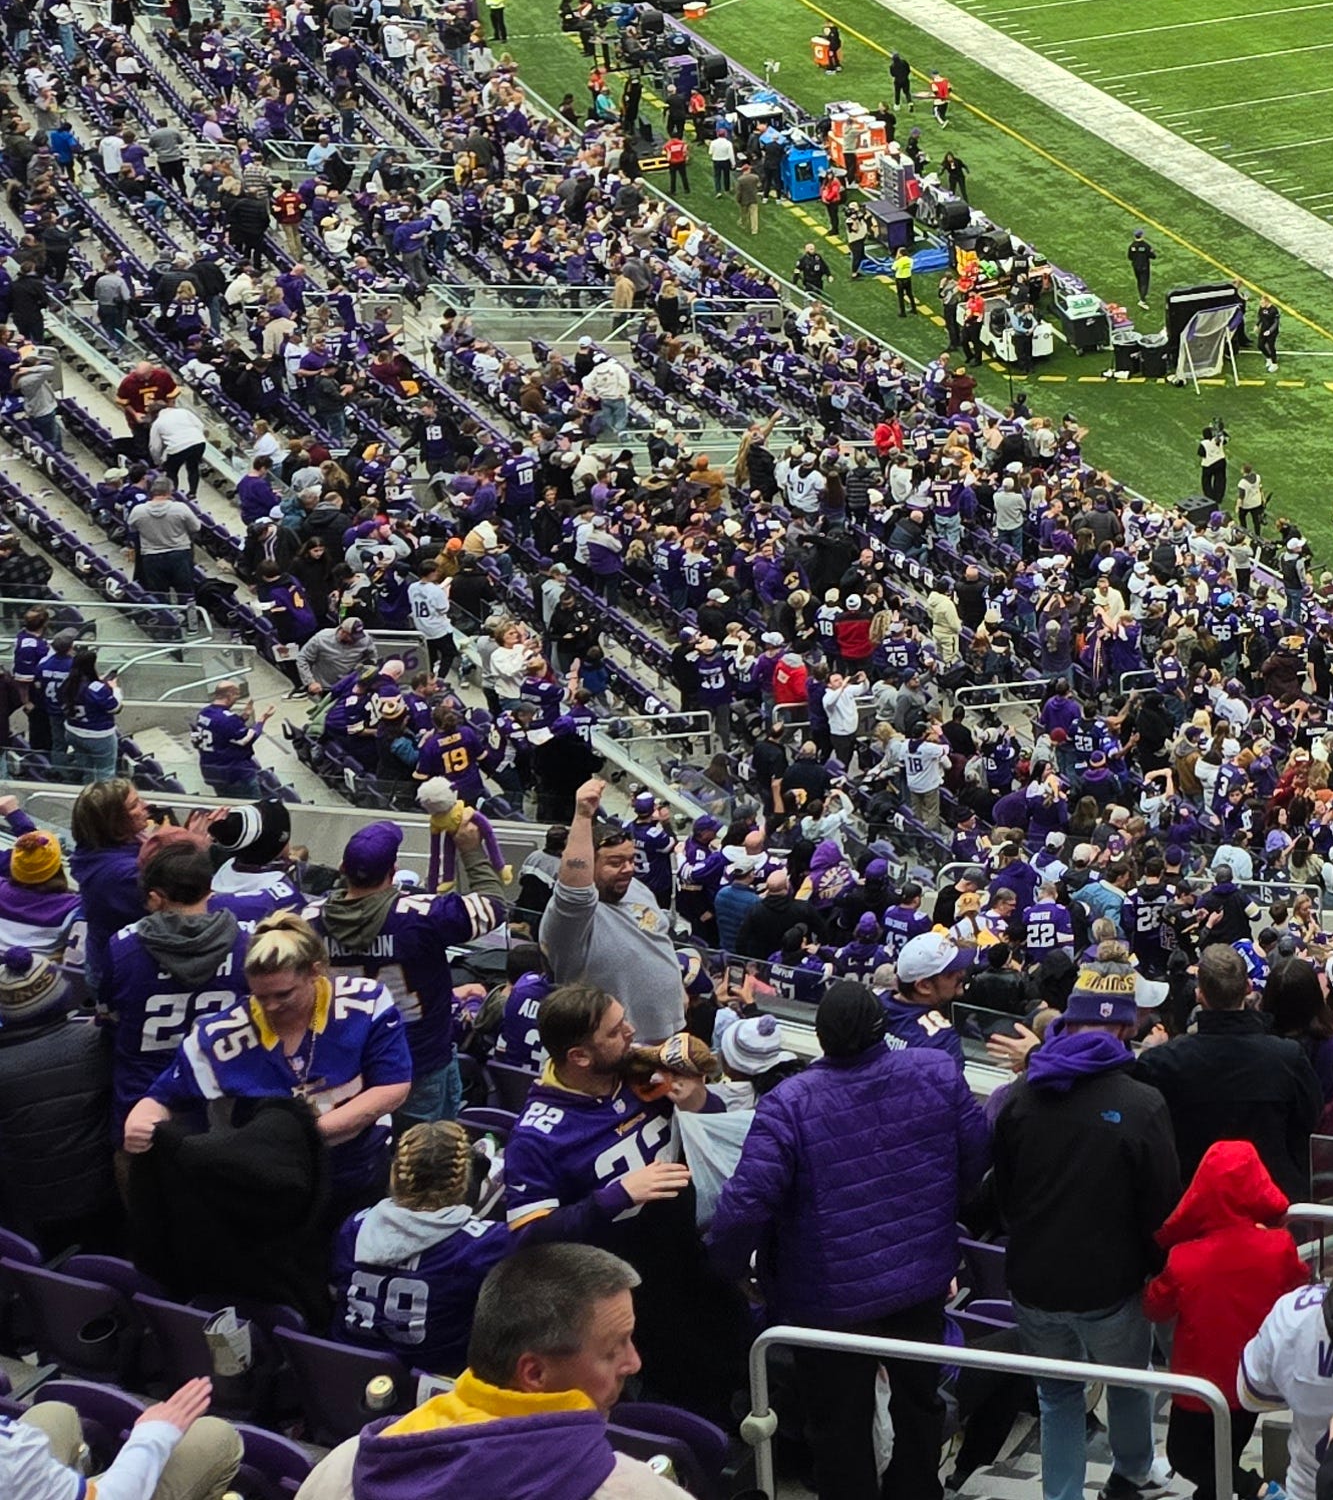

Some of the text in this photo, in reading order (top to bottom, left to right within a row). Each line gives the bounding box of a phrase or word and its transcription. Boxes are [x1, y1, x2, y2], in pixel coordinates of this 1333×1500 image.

[440, 747, 470, 772] 19
[908, 756, 923, 772] 18
[1026, 922, 1055, 948] 22
[334, 974, 376, 1021] 75
[204, 1006, 258, 1062] 75
[519, 1100, 565, 1135] 22
